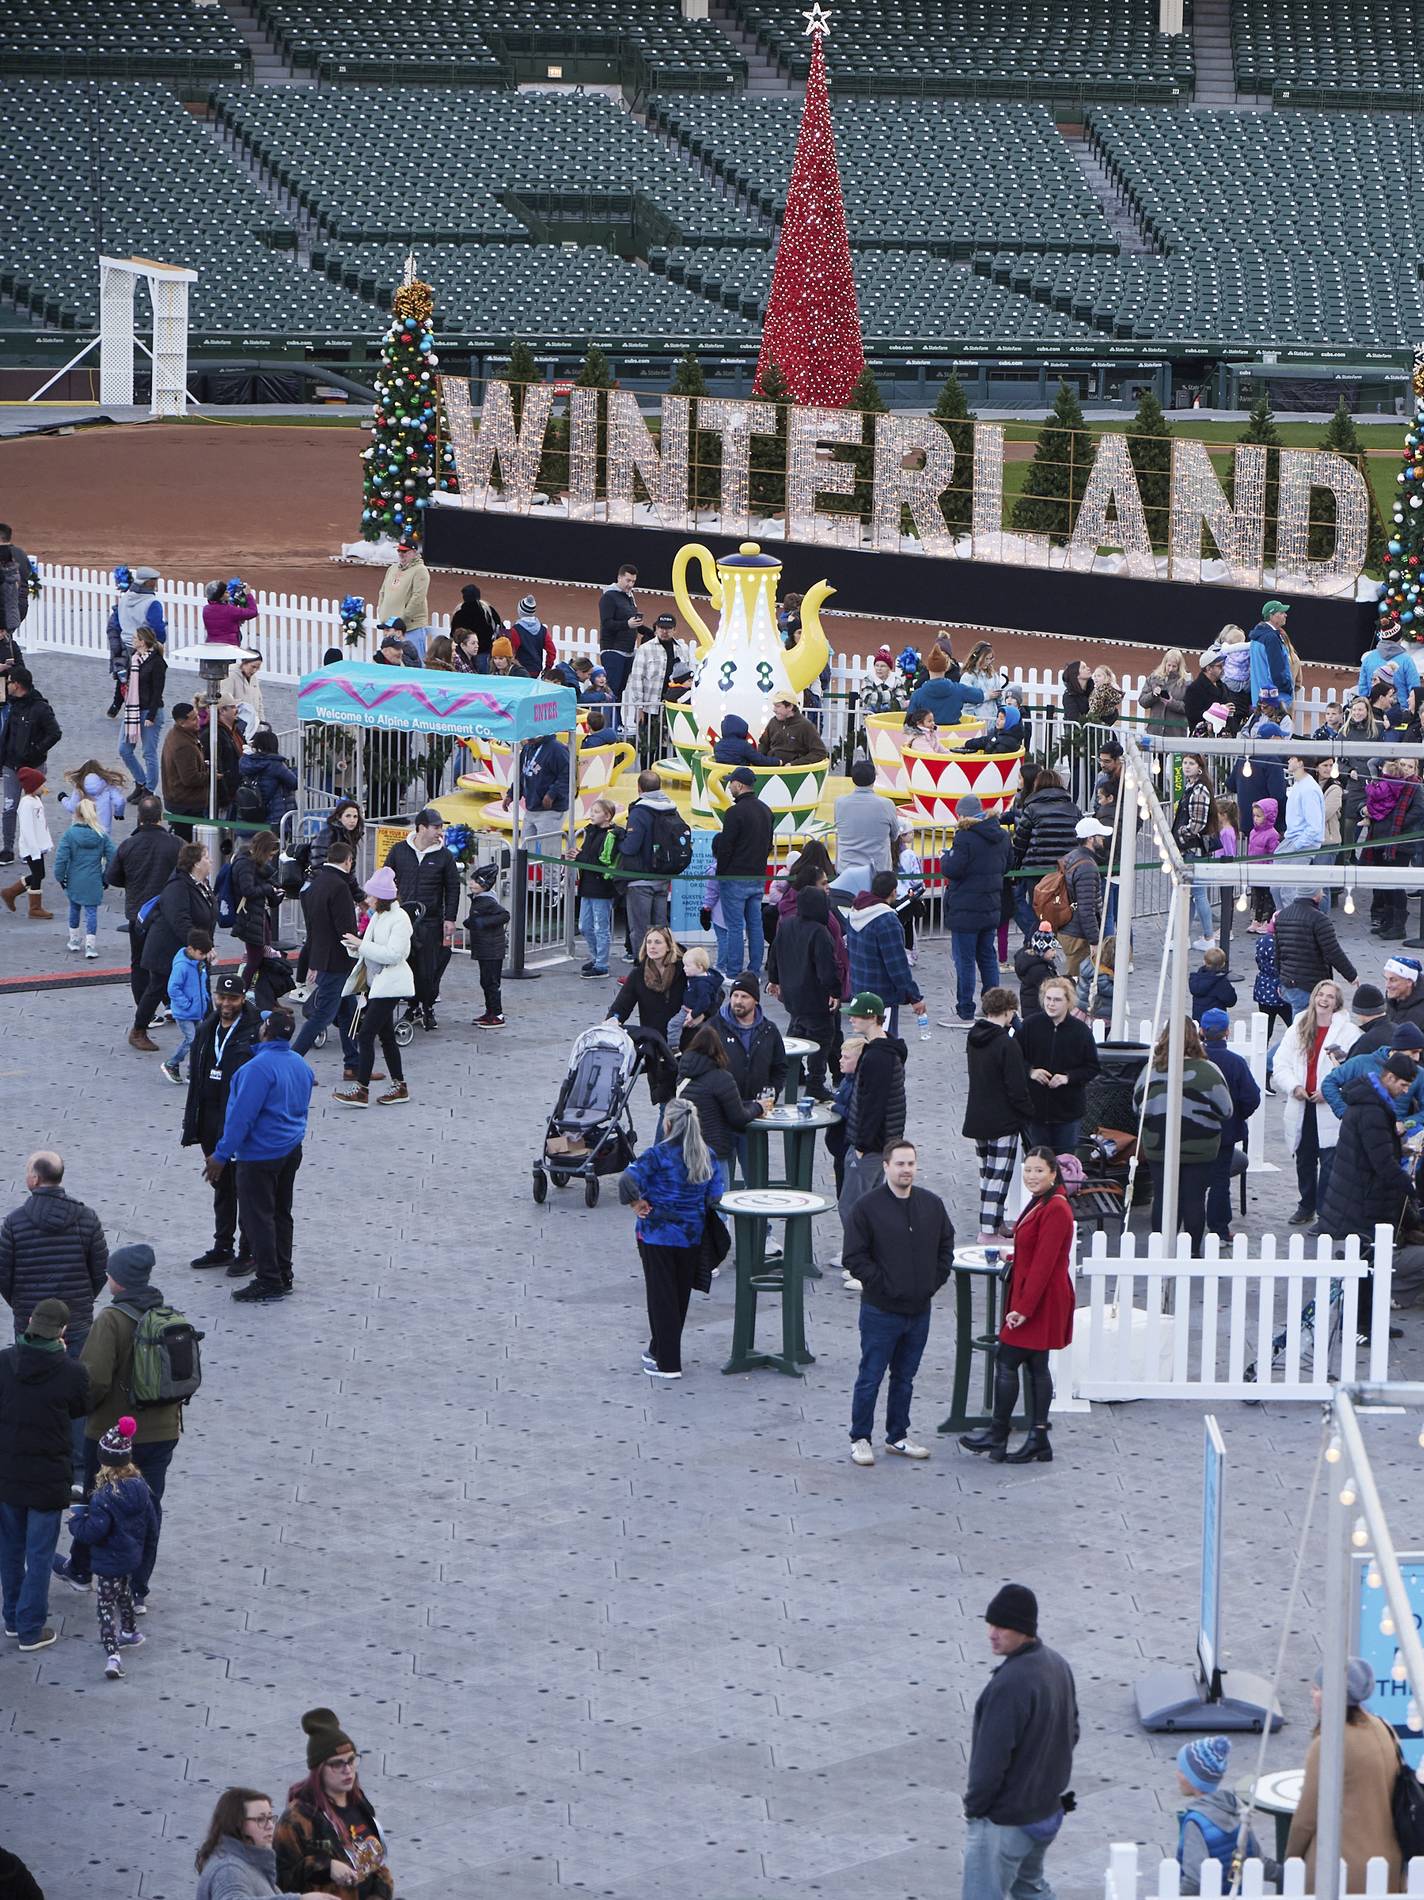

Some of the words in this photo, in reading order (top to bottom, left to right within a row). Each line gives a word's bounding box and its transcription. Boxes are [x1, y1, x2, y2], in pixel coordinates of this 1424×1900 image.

[439, 376, 1369, 598] WINTERLAND
[316, 706, 362, 722] Welcome
[364, 713, 375, 724] to
[377, 715, 409, 728] Alpine
[412, 718, 474, 735] Amusement
[475, 724, 494, 736] Co.
[534, 701, 558, 722] ENTER
[225, 980, 233, 988] C
[1375, 1679, 1413, 1697] THI
